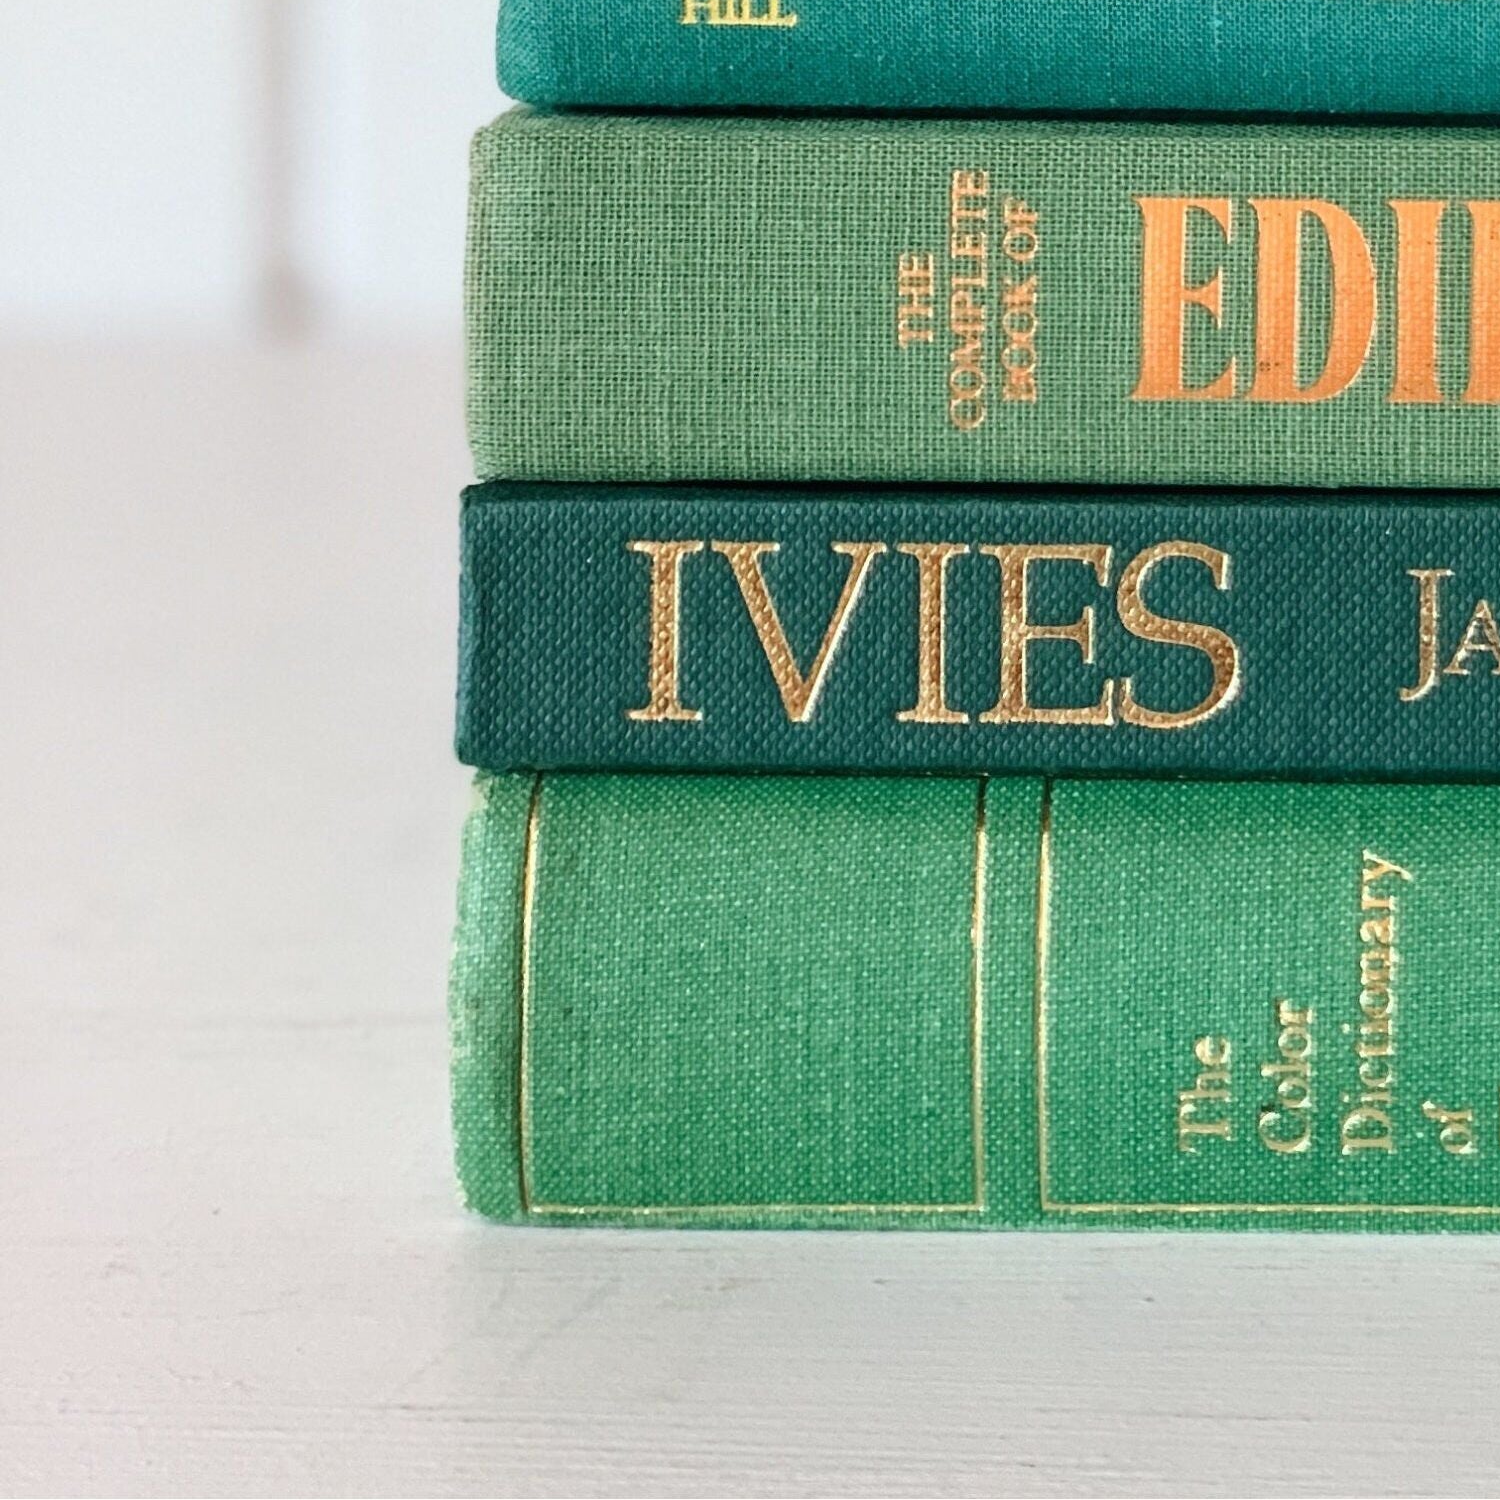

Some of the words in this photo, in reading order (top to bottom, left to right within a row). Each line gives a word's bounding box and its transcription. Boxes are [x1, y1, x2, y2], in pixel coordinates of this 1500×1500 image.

[1002, 193, 1038, 261] OF
[898, 252, 934, 349] THE
[950, 170, 988, 431] COMPLETE
[1002, 275, 1037, 403] BOOK
[628, 539, 1241, 730] IVIES
[1341, 849, 1413, 1155] Dictionary
[1178, 1035, 1232, 1154] The
[1259, 997, 1313, 1154] Color
[1423, 1100, 1473, 1155] of
